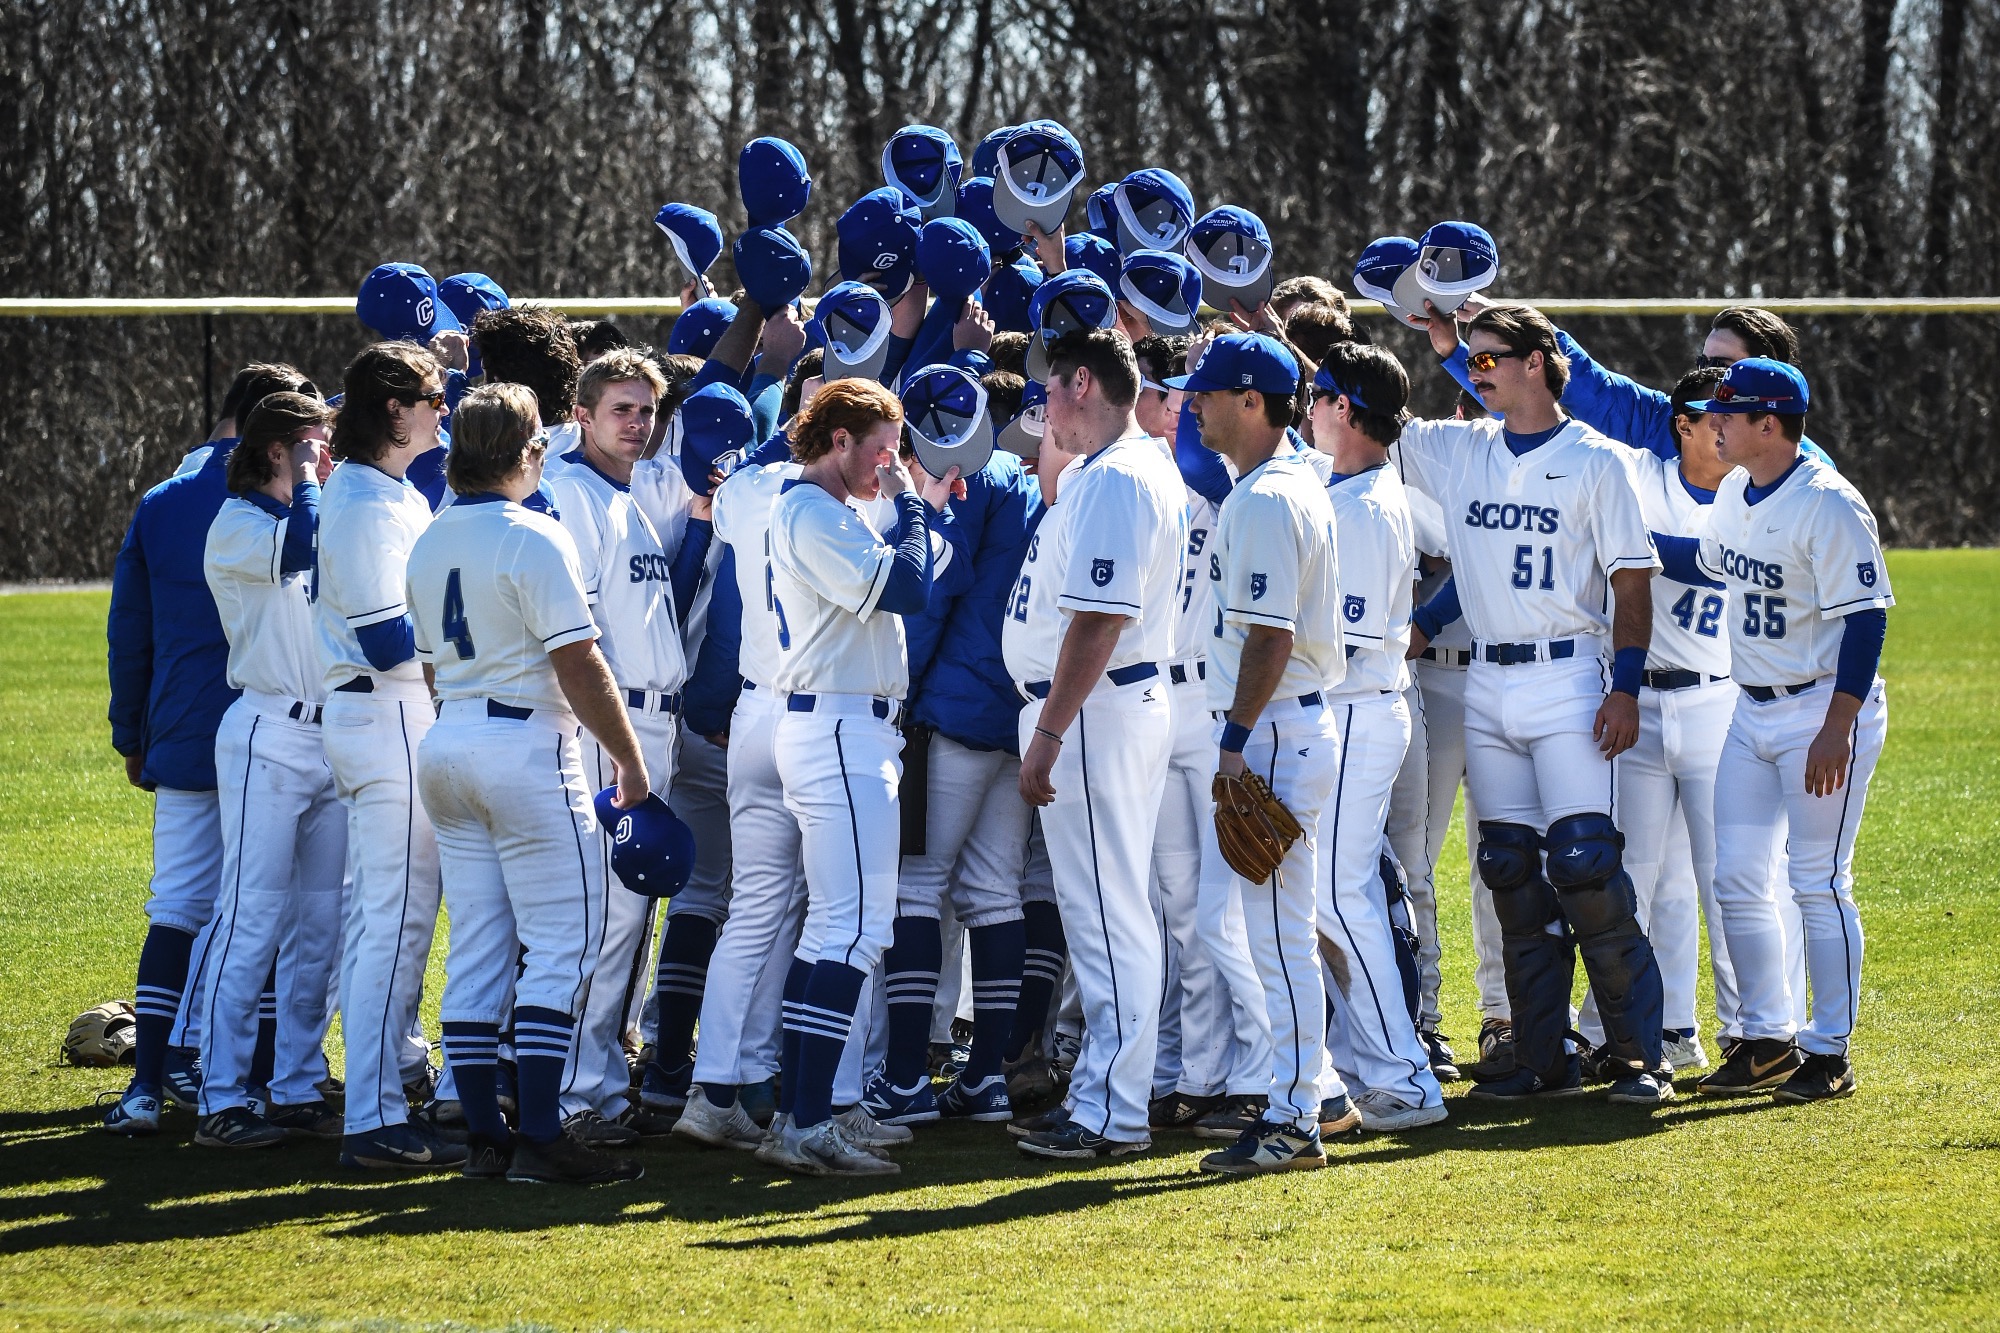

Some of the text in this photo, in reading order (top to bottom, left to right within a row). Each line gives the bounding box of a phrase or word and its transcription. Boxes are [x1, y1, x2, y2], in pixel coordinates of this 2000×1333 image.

[1206, 218, 1237, 226] COVENANT
[873, 252, 899, 269] C
[415, 296, 434, 327] C
[1465, 500, 1560, 534] SCOTS
[629, 553, 670, 583] SCOT
[1096, 567, 1107, 581] C
[1511, 544, 1555, 591] 51
[1719, 543, 1785, 590] COTS
[1863, 570, 1873, 583] C
[442, 567, 476, 661] 4
[1348, 603, 1360, 618] C
[1671, 587, 1725, 638] 42
[1742, 592, 1788, 639] 55
